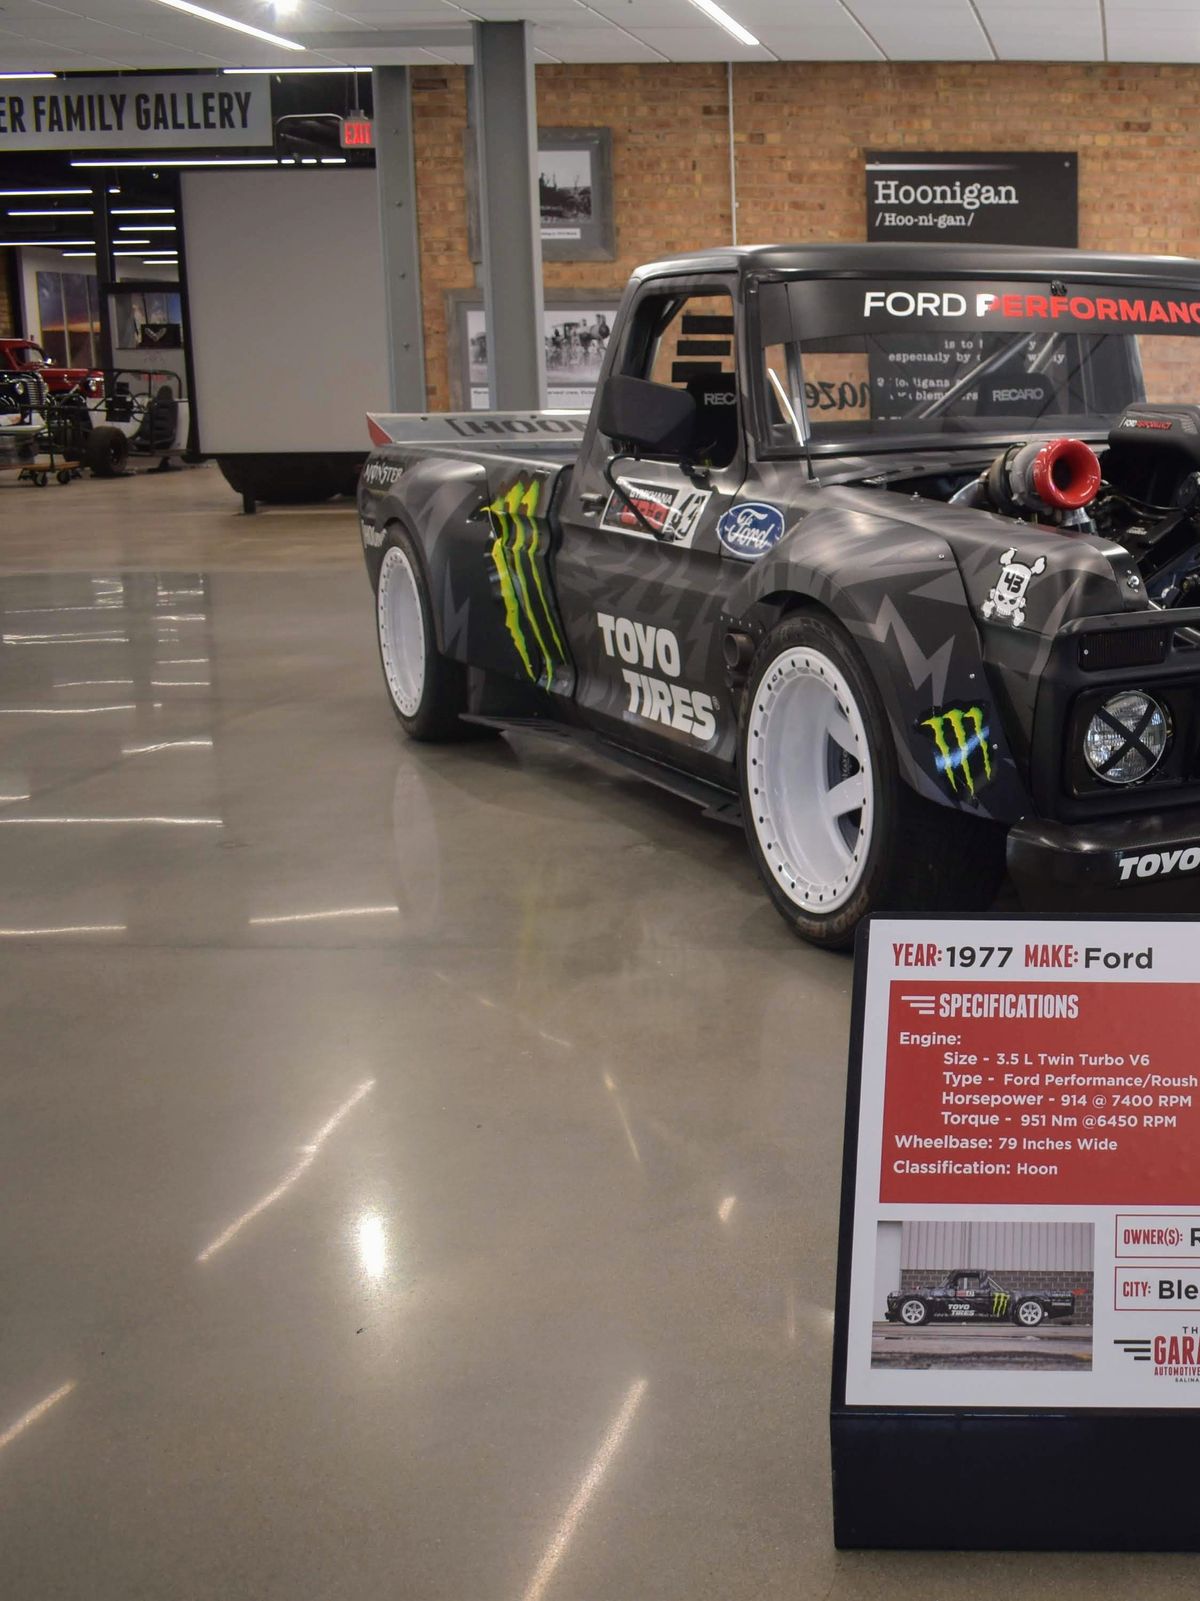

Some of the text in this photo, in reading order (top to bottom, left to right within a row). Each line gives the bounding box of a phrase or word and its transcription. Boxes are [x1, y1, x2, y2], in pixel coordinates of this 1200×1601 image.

[35, 93, 127, 132] FAMILY
[135, 91, 252, 131] GALLERY
[343, 121, 372, 146] EXIT
[873, 180, 1019, 210] Hoonigan
[863, 291, 967, 318] FORD
[992, 387, 1044, 403] RECARO
[724, 507, 774, 549] Ford
[1003, 571, 1026, 594] 43
[596, 611, 682, 678] TOYO
[621, 667, 718, 741] TIRES
[892, 942, 1153, 970] YEAR: 1977 MAKE: Ford
[938, 992, 1079, 1019] SPECIFICATIONS
[899, 1031, 962, 1048] Engine:
[943, 1051, 1151, 1067] Size 3.5 L Twin Turbo V6
[942, 1071, 1199, 1089] Type Ford Performance/Roush
[942, 1091, 1192, 1108] Horsepower 914 7400 RPM
[940, 1111, 1000, 1128] Torque
[1020, 1113, 1047, 1127] 951
[1051, 1114, 1078, 1127] Nm
[1142, 1115, 1177, 1128] RPM
[894, 1134, 1119, 1151] Wheelbase: 79 Inches Wide
[892, 1159, 1058, 1176] Classification: Hoon
[1123, 1227, 1184, 1247] OWNER(S):
[1122, 1281, 1152, 1298] CITY:
[1153, 1365, 1200, 1377] AUTOMOTIVE
